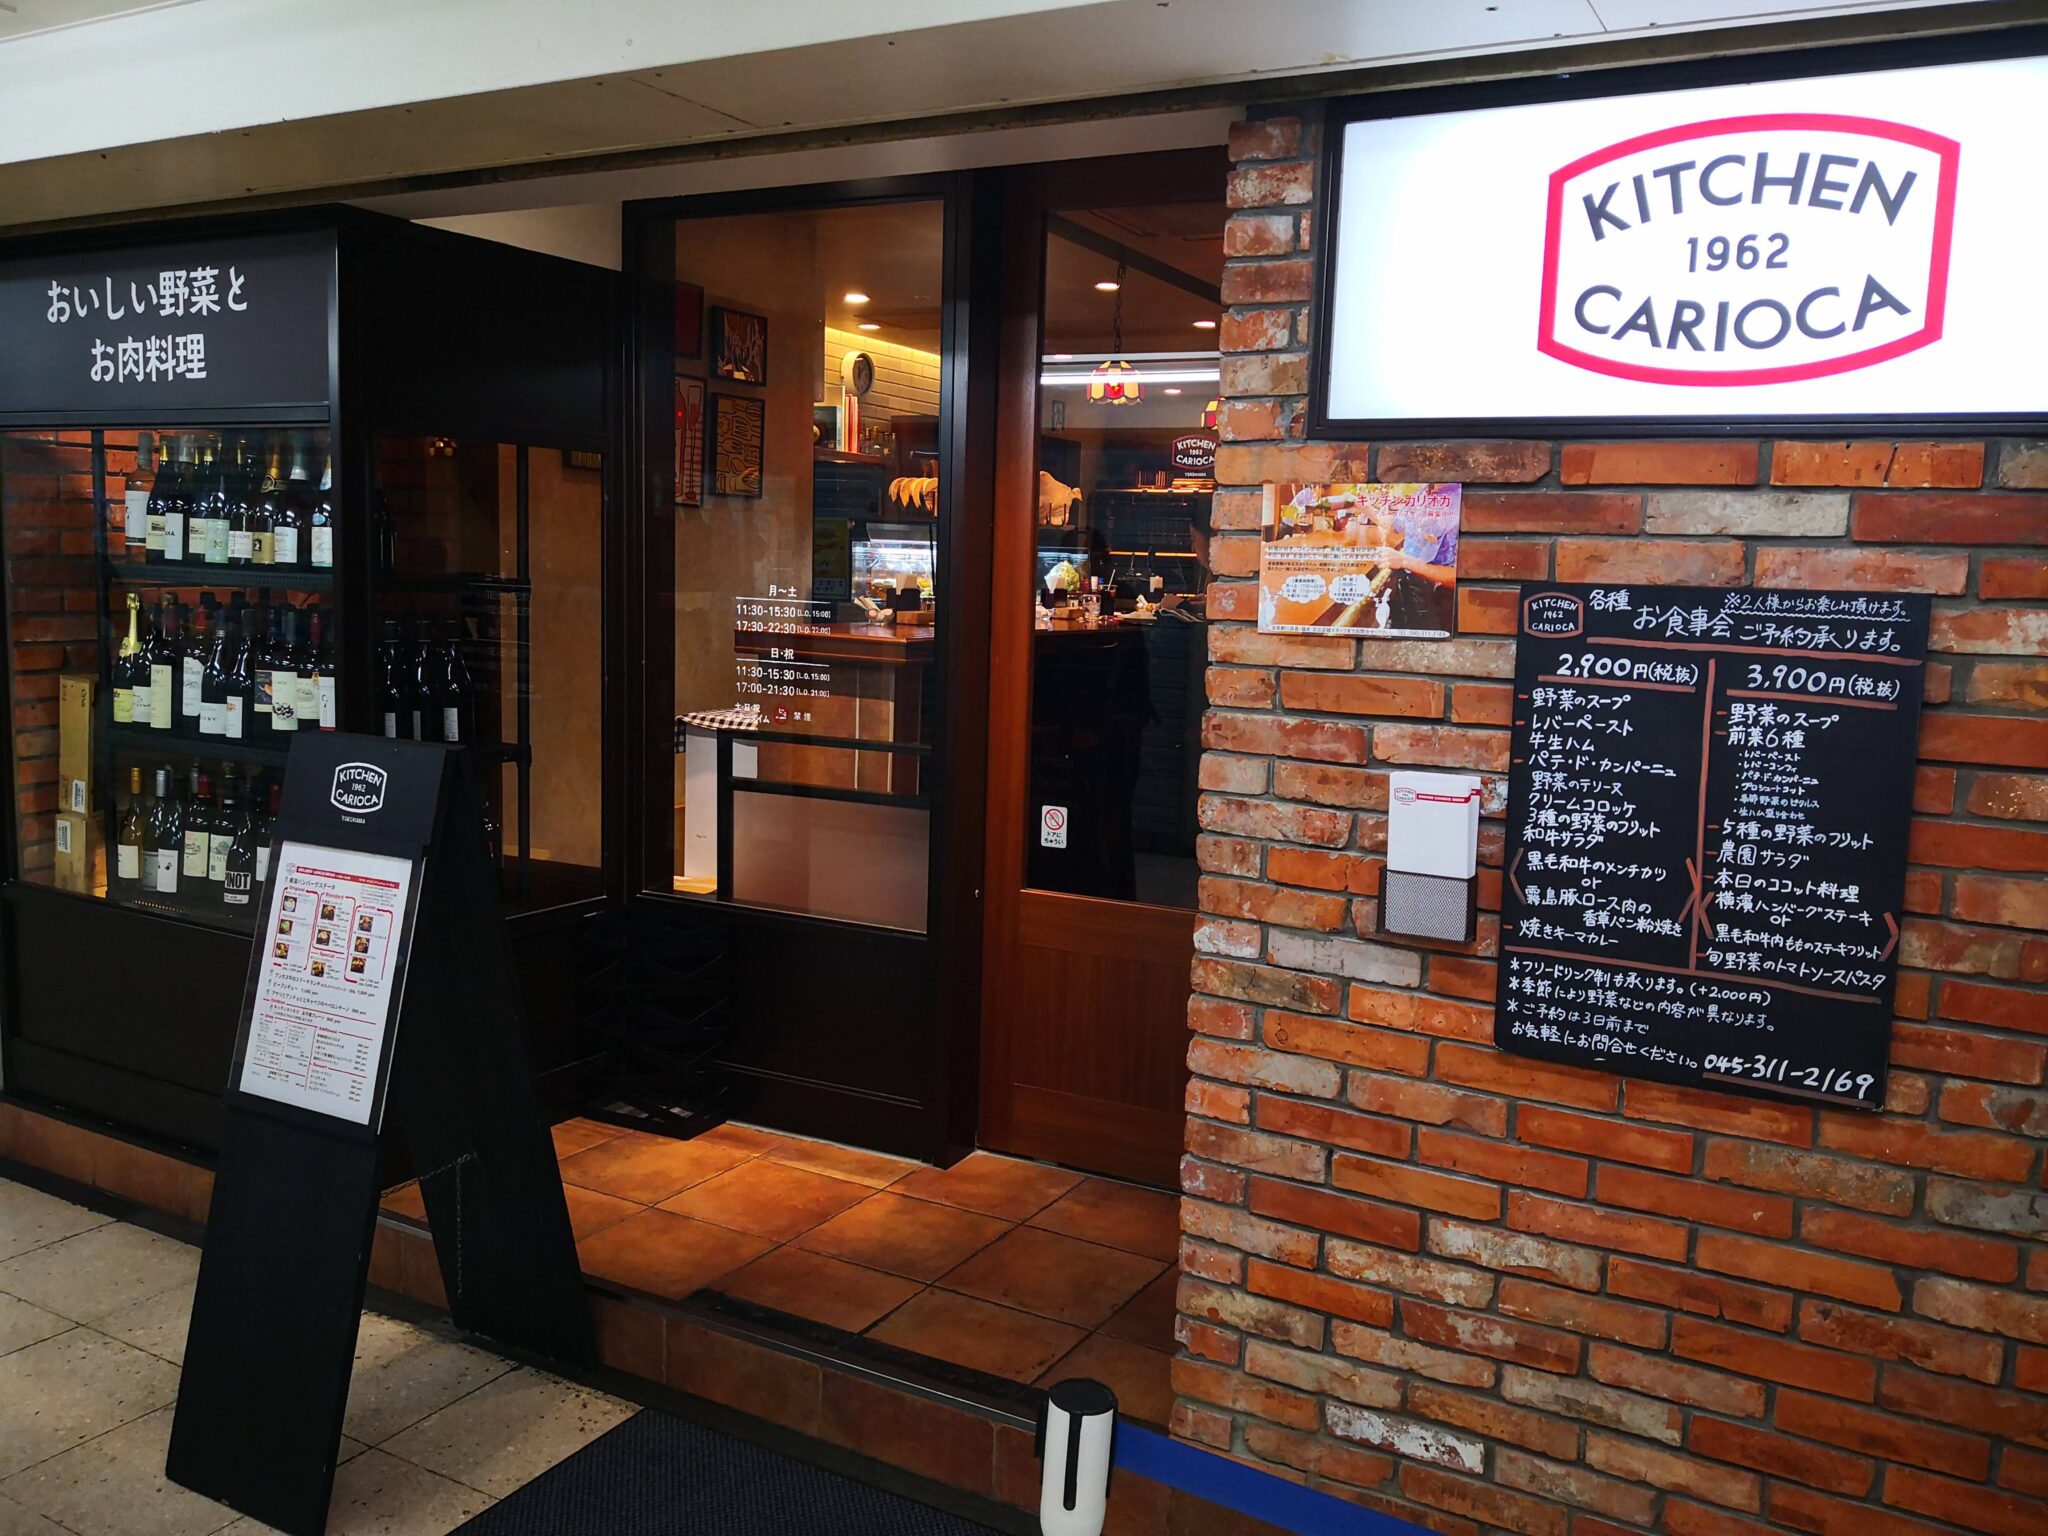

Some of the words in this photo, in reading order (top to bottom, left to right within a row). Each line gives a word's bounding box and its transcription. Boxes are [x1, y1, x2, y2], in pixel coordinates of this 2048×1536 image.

[1582, 151, 1918, 242] KITCHEN
[1686, 232, 1791, 273] 1962
[46, 265, 249, 324] おいしい野菜と
[1573, 273, 1912, 352] CARIOCA
[89, 333, 208, 383] お肉料理
[1176, 438, 1217, 451] KITCHEN
[1175, 454, 1216, 466] CARIOCA
[736, 603, 796, 618] 11:30-15:30
[1531, 598, 1579, 611] KITCHEN
[1589, 588, 1632, 613] 各種
[736, 620, 796, 634] 17:30-22:30
[1531, 621, 1576, 633] CARIOCA
[1543, 610, 1564, 619] 1962
[736, 665, 795, 681] 11:30-15:30
[736, 681, 795, 697] 17:00-21:30
[1532, 687, 1632, 712] 野菜のスープ
[1532, 713, 1635, 737] レバーペースト
[1727, 703, 1840, 730] 野菜のスープ
[1529, 731, 1595, 752] 牛生ハム
[1727, 725, 1806, 749] 前菜6種
[339, 768, 383, 787] KITCHEN
[351, 783, 367, 793] 1962
[335, 789, 379, 807] CARIOCA
[1528, 792, 1637, 819] クリームコロッケ
[1527, 806, 1661, 839] 3種の野菜のフリット
[1722, 818, 1875, 850] 5種の野菜のフリット
[1522, 824, 1605, 850] 和牛サラダ
[1526, 850, 1668, 882] 黒毛和牛のメンチカツ
[1716, 838, 1811, 870] 農園サラダ
[1581, 877, 1602, 889] or
[1713, 867, 1861, 904] 本日のココット料理
[1518, 916, 1620, 946] 焼きキーマカレー
[1769, 914, 1792, 928] or
[1706, 946, 1888, 992] 旬野菜のトマトソースパスタ
[1703, 1052, 1875, 1100] 045-311-2169
